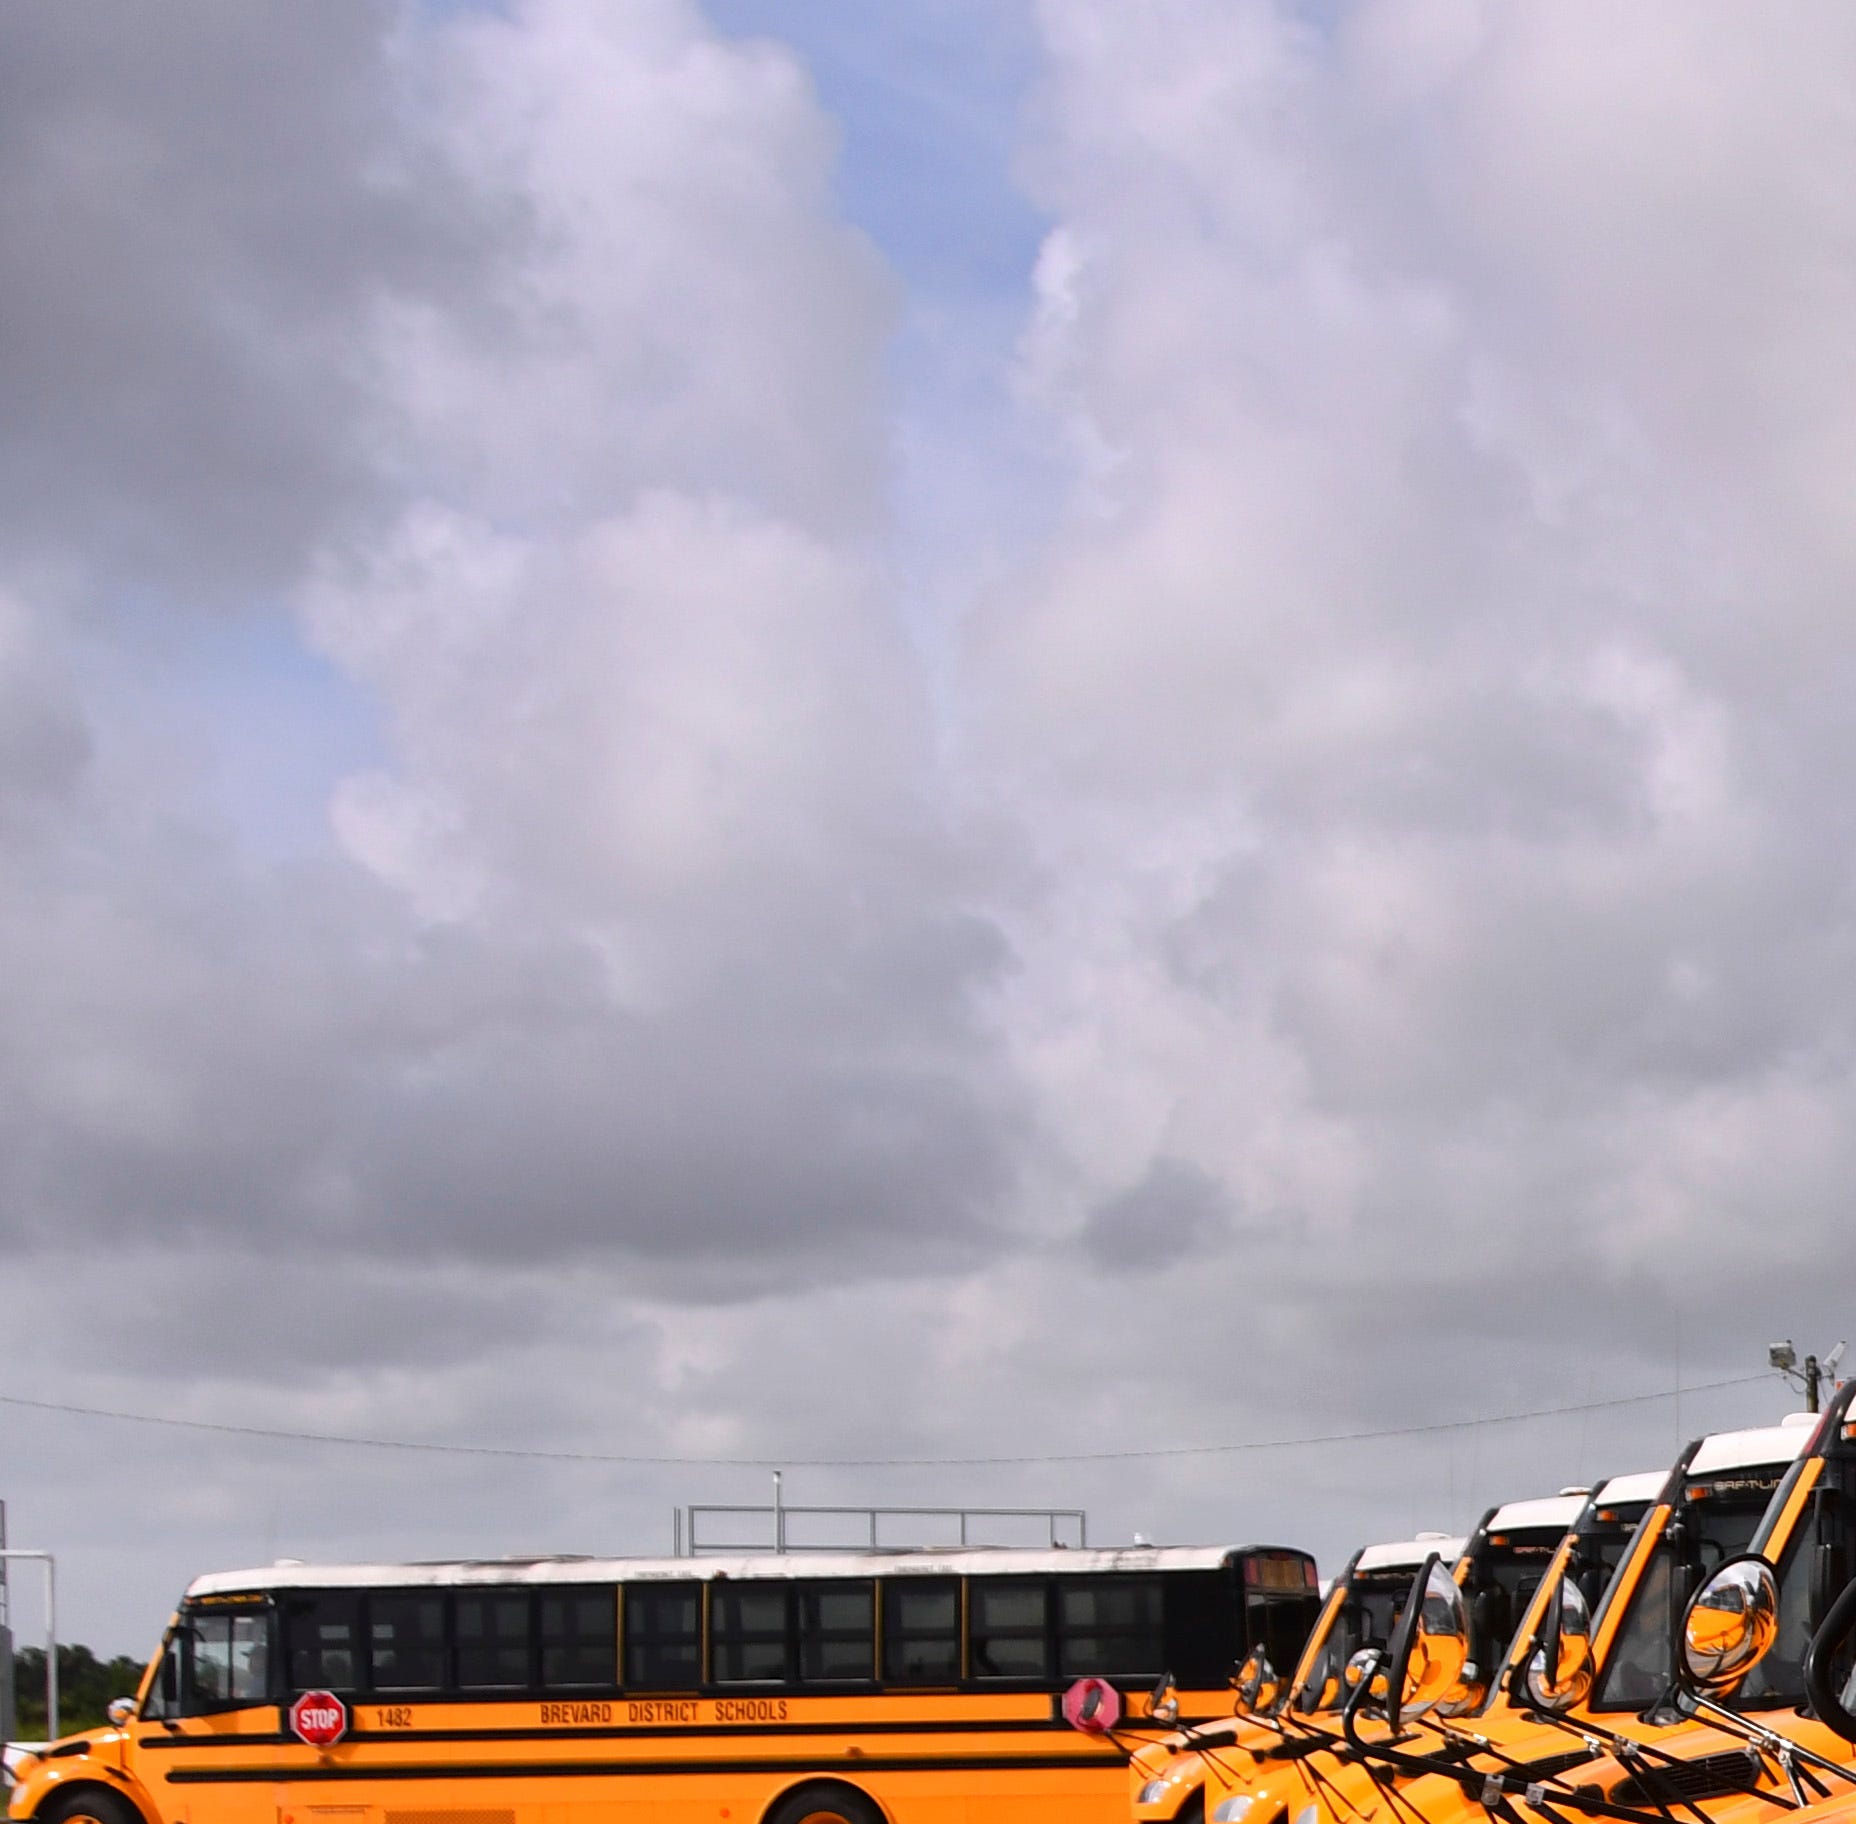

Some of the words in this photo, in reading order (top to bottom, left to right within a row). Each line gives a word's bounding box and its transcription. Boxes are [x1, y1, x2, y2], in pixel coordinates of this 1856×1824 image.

[300, 1709, 339, 1730] STOP
[377, 1708, 412, 1727] 1482
[540, 1703, 612, 1724] BREVARD
[628, 1702, 699, 1723] DISTRICT
[714, 1701, 788, 1722] SCHOOLS
